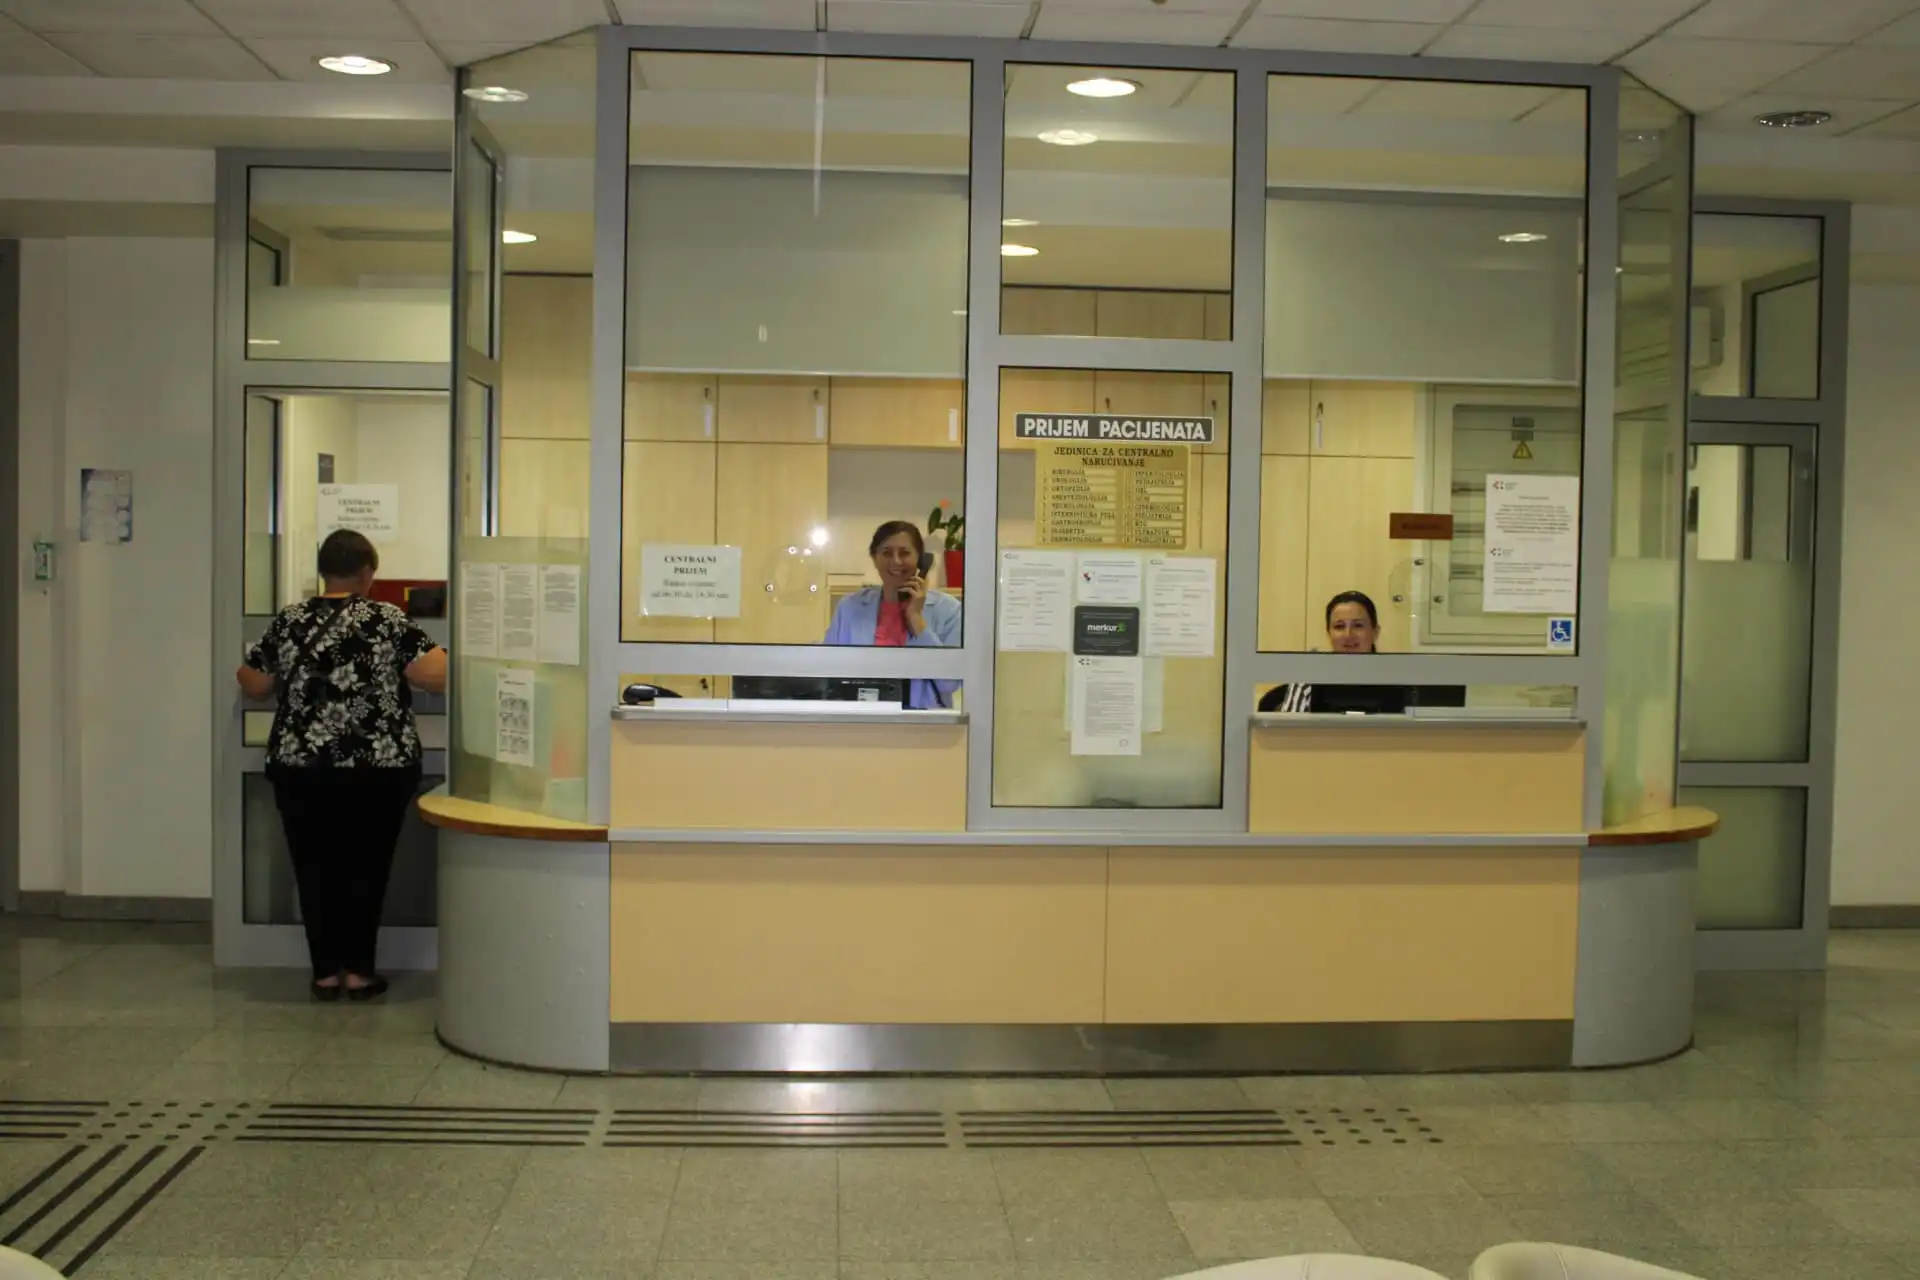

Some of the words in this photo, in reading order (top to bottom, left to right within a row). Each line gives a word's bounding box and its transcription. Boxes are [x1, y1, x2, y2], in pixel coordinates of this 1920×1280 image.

[1024, 417, 1089, 437] PRIJEM
[1099, 419, 1206, 440] PACIJENATA
[1054, 446, 1098, 456] JEDINICA
[1102, 447, 1114, 456] ZA
[1118, 448, 1174, 458] CENTRALNO
[663, 555, 717, 563] CENTRALNI
[1087, 623, 1118, 632] merkur
